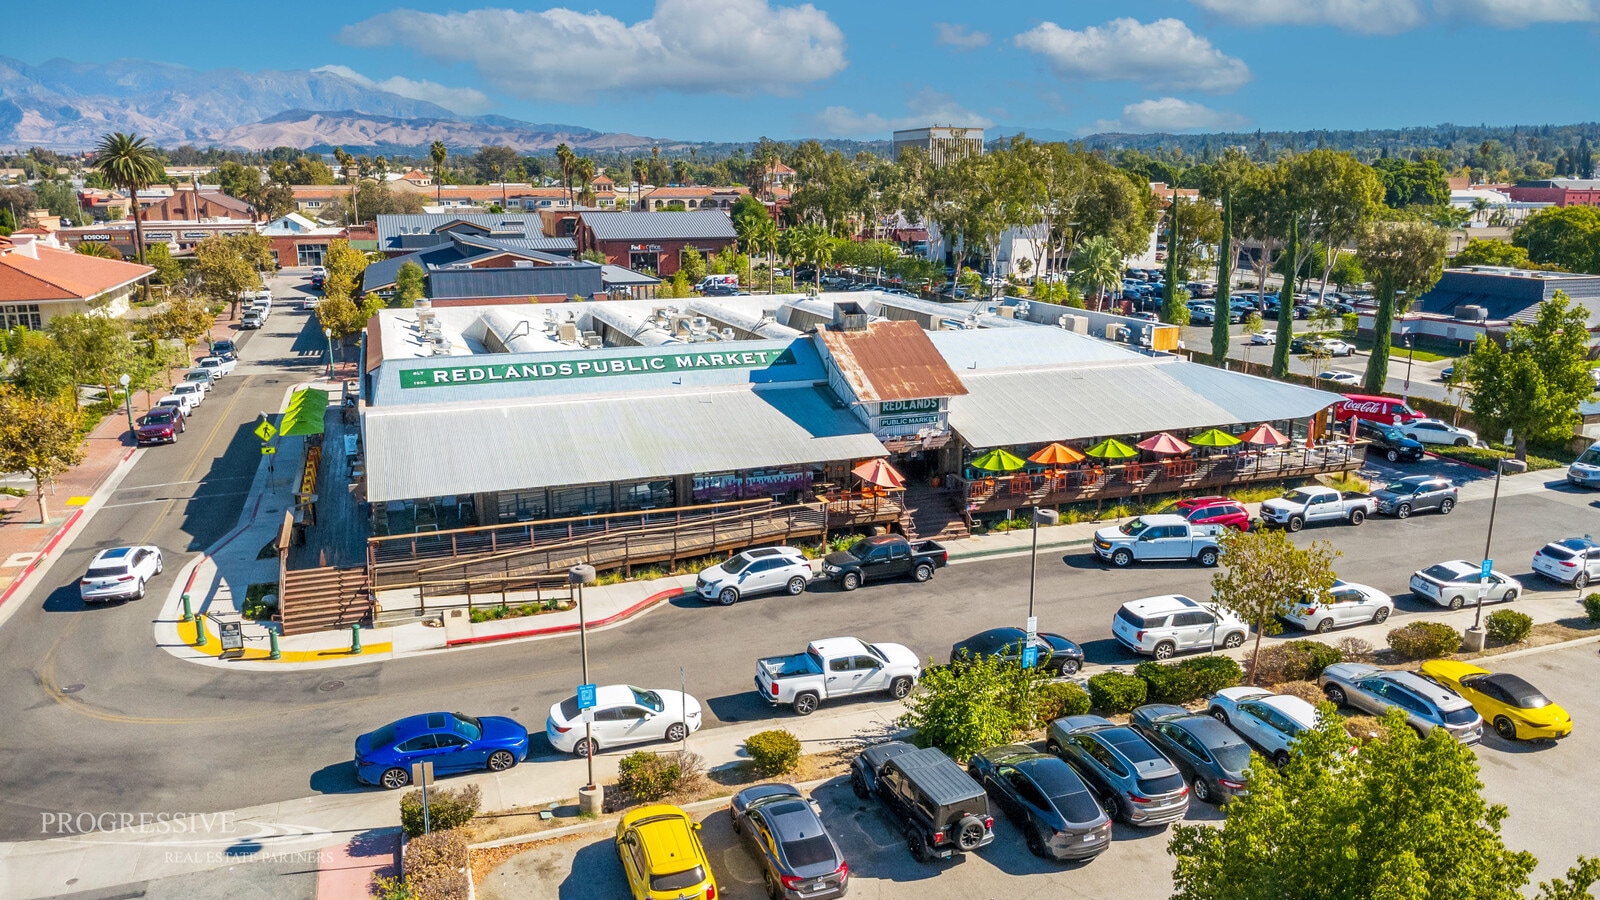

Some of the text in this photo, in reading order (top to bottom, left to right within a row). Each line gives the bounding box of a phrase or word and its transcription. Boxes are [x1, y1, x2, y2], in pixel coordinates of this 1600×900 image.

[713, 276, 736, 285] FedEx
[433, 351, 770, 384] REDLANDS PUBLIC MARKET
[882, 398, 938, 412] REDLANDS
[1343, 400, 1382, 414] Coca-Cola
[881, 416, 937, 426] PUBLIC MARKET
